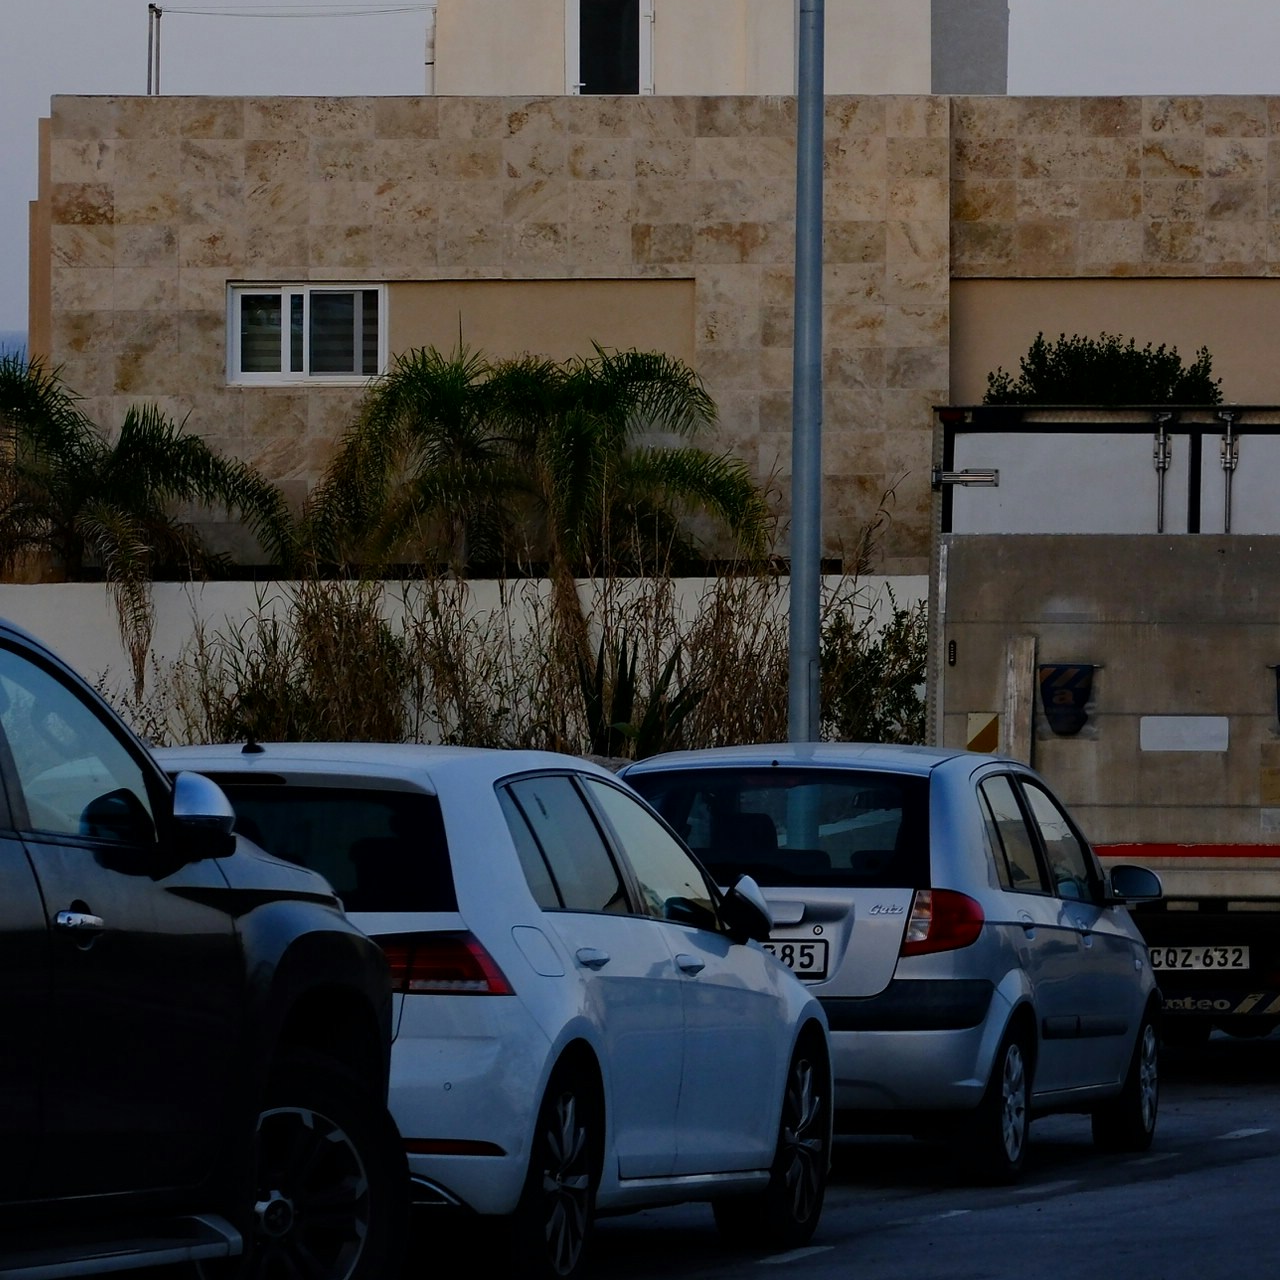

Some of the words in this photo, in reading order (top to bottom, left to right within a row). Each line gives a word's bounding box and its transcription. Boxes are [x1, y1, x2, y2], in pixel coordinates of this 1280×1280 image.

[1151, 949, 1193, 968] CQZ
[1202, 948, 1243, 967] 632
[1161, 996, 1231, 1010] nteo
